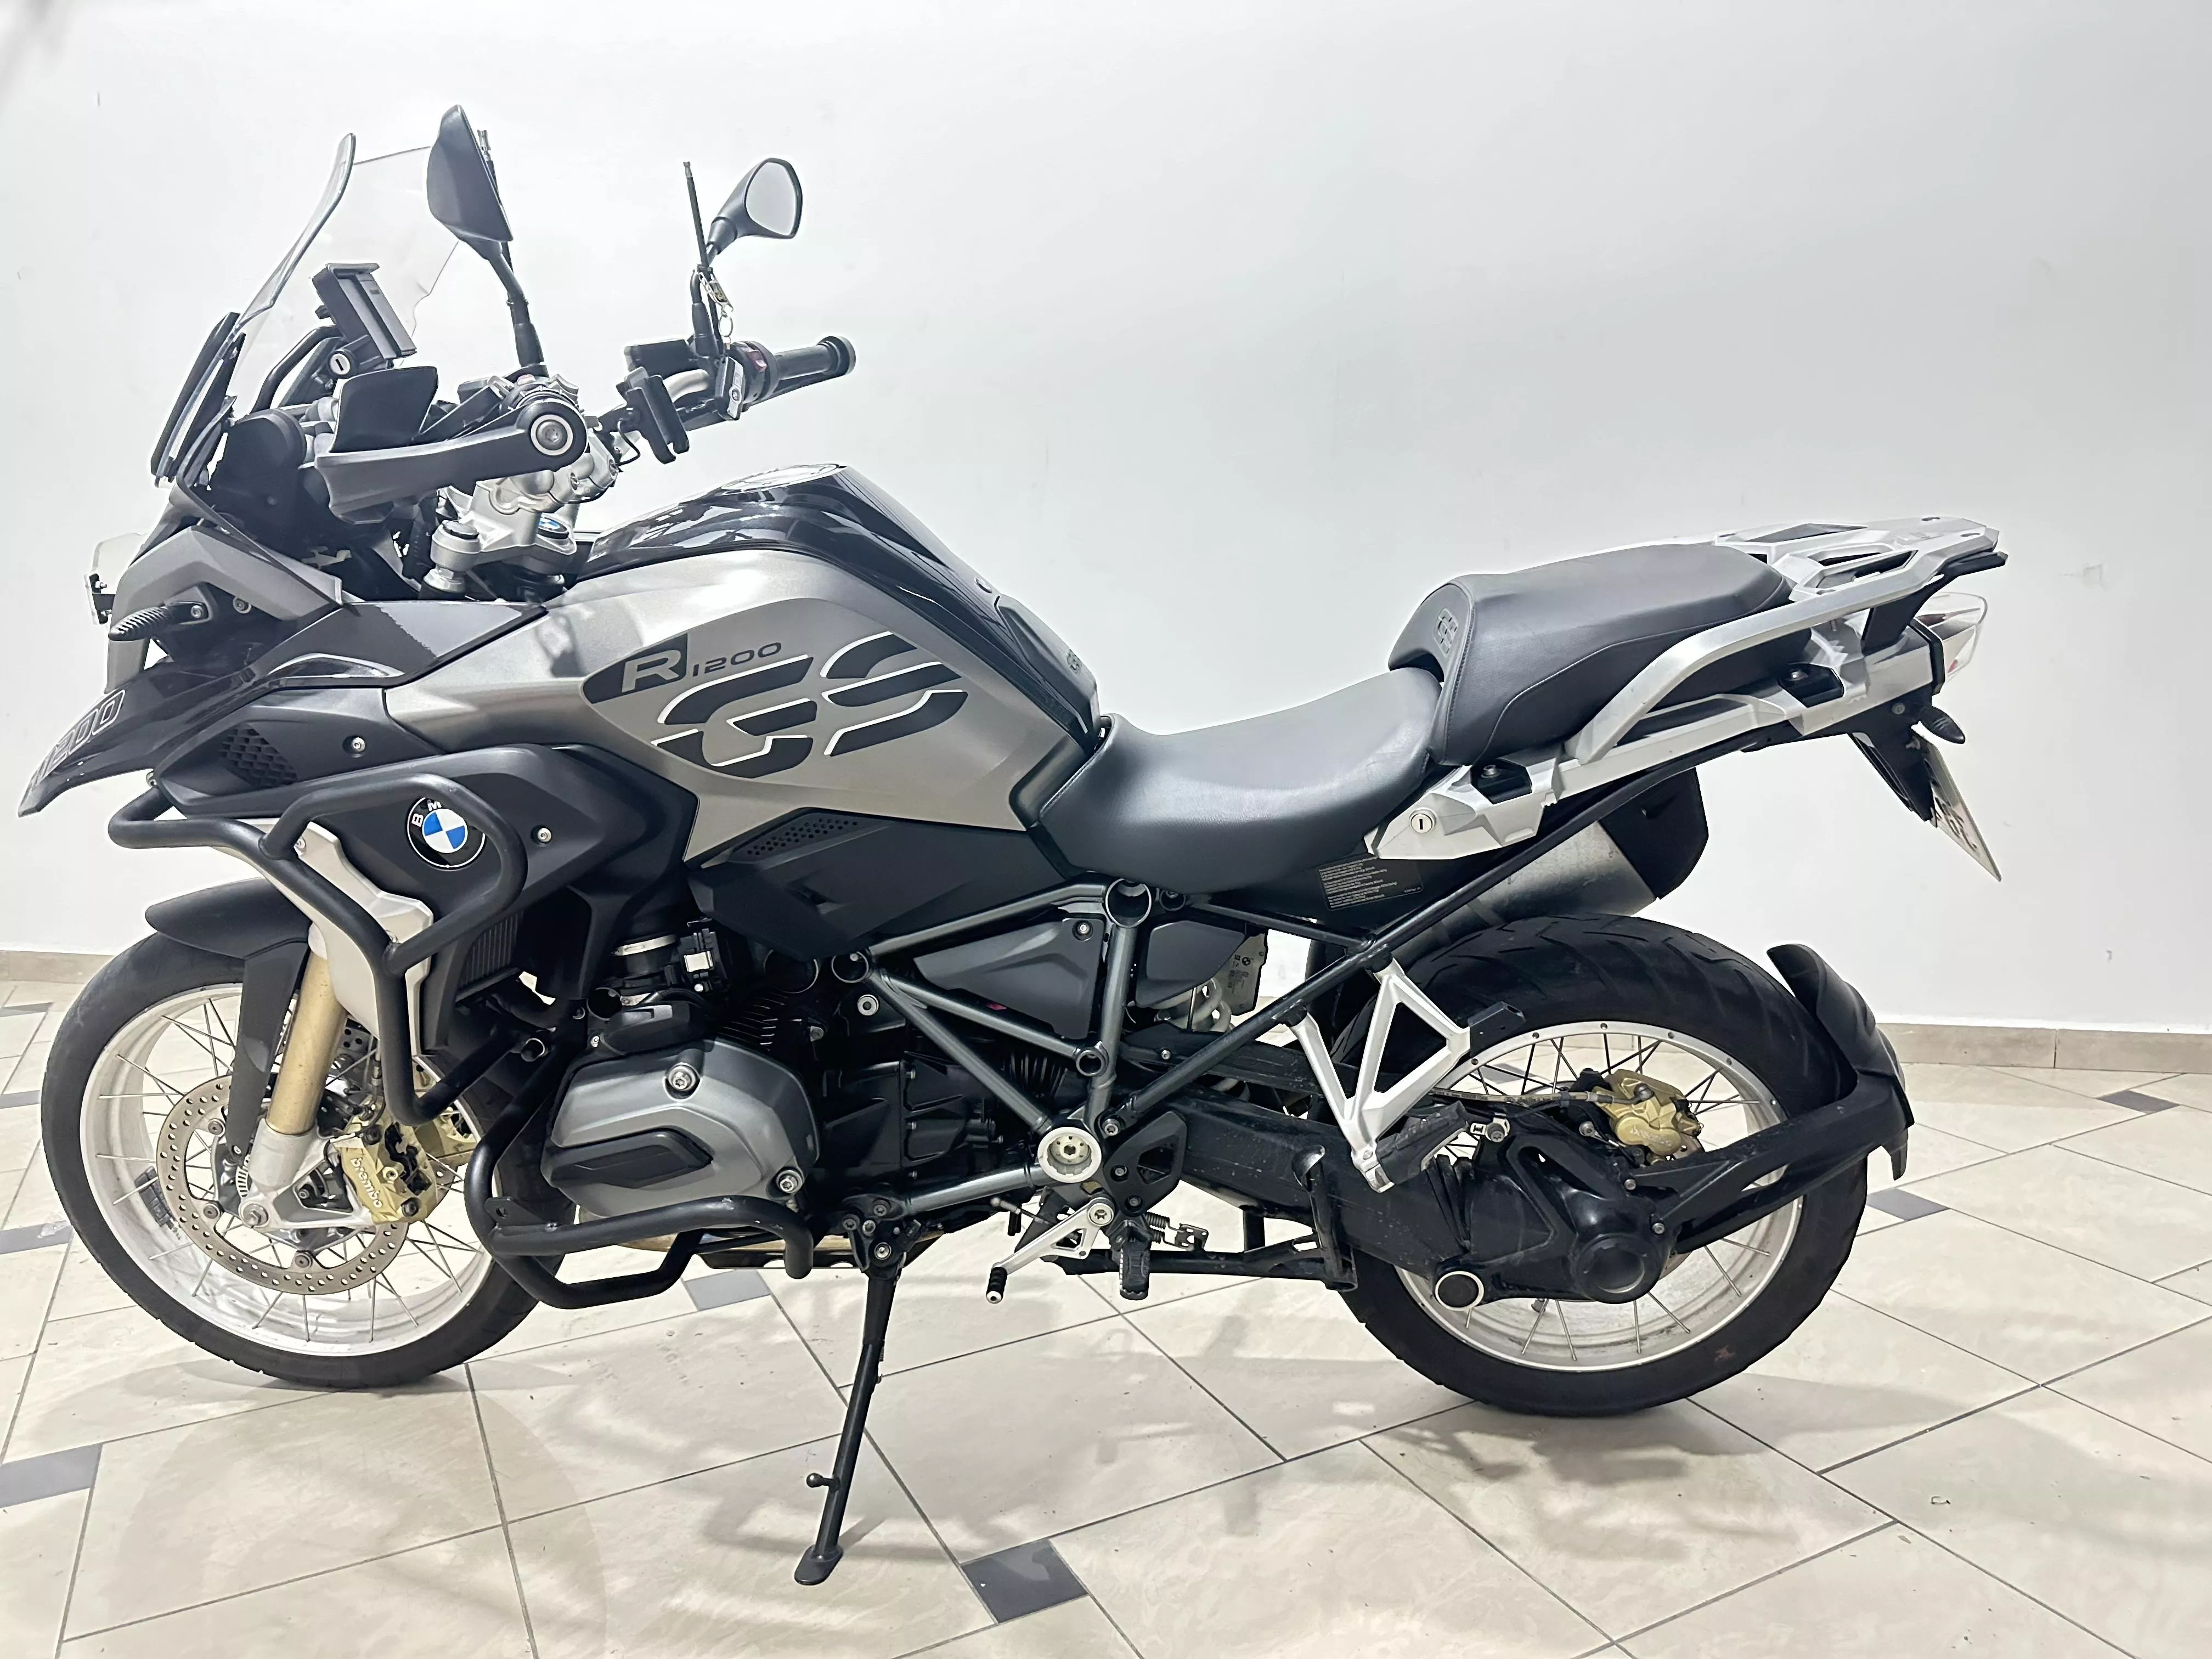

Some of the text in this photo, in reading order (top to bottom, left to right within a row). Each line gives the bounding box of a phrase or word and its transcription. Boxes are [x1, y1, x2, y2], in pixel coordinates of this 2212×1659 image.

[621, 641, 782, 693] R 1200
[651, 630, 968, 778] GS
[350, 1156, 383, 1208] brembo
